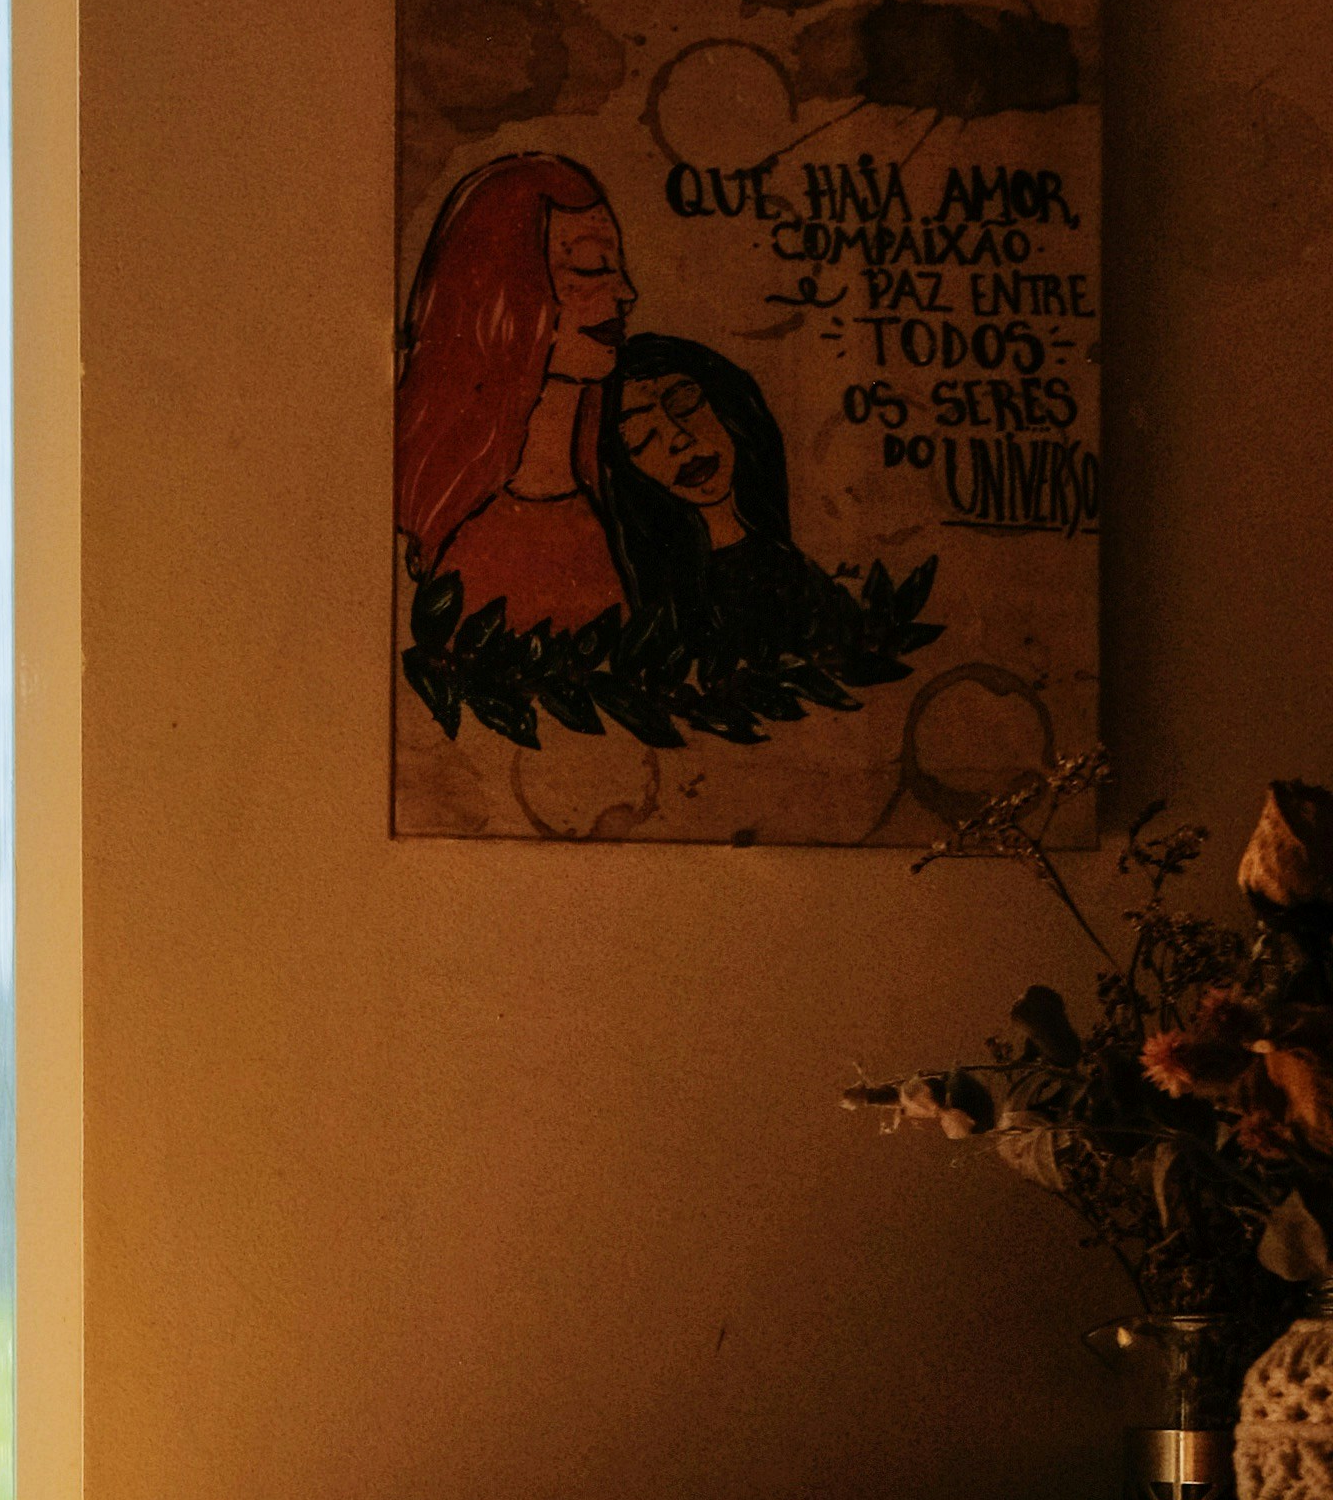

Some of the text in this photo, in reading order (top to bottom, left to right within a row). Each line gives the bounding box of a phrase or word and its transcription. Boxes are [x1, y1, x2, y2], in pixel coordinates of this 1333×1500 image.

[665, 161, 781, 220] QUE
[802, 153, 913, 223] HAJA
[764, 267, 1097, 318] e PAZ ENTRE
[853, 316, 1046, 375] TODOS
[843, 377, 1079, 433] OS SERES
[884, 432, 1101, 540] DO UNIVERSO
